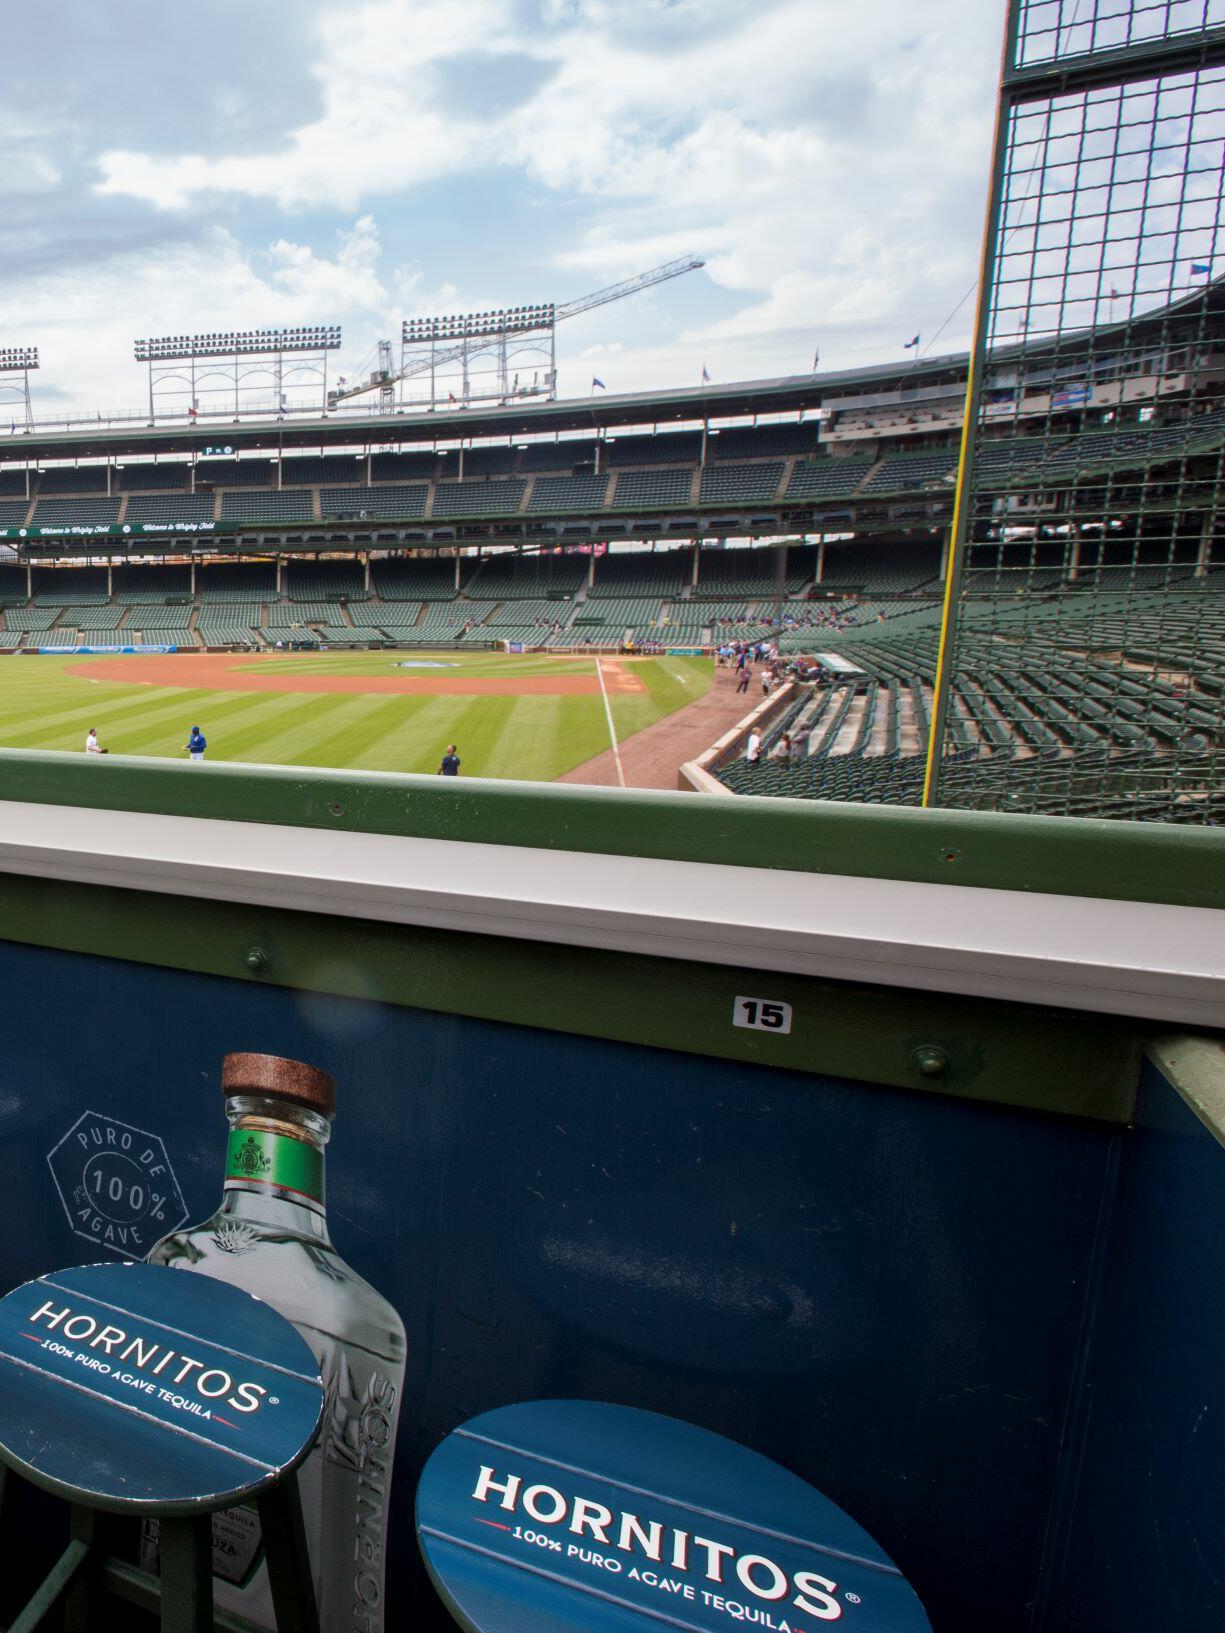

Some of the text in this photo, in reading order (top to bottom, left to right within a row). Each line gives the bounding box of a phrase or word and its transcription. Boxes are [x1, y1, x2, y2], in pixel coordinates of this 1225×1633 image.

[71, 527, 93, 535] Wrigley
[175, 523, 198, 532] Wrigley
[199, 522, 216, 530] Field
[742, 1001, 784, 1028] 15
[77, 1127, 166, 1177] PURO DE
[92, 1169, 167, 1221] 100%
[77, 1207, 144, 1245] AGAVE
[75, 1353, 111, 1374] PURO
[111, 1370, 156, 1394] AGAVE
[157, 1388, 212, 1420] TEQUILA
[567, 1544, 622, 1574] PURO
[628, 1566, 695, 1601] AGAVE
[700, 1589, 792, 1633] TEQUILA
